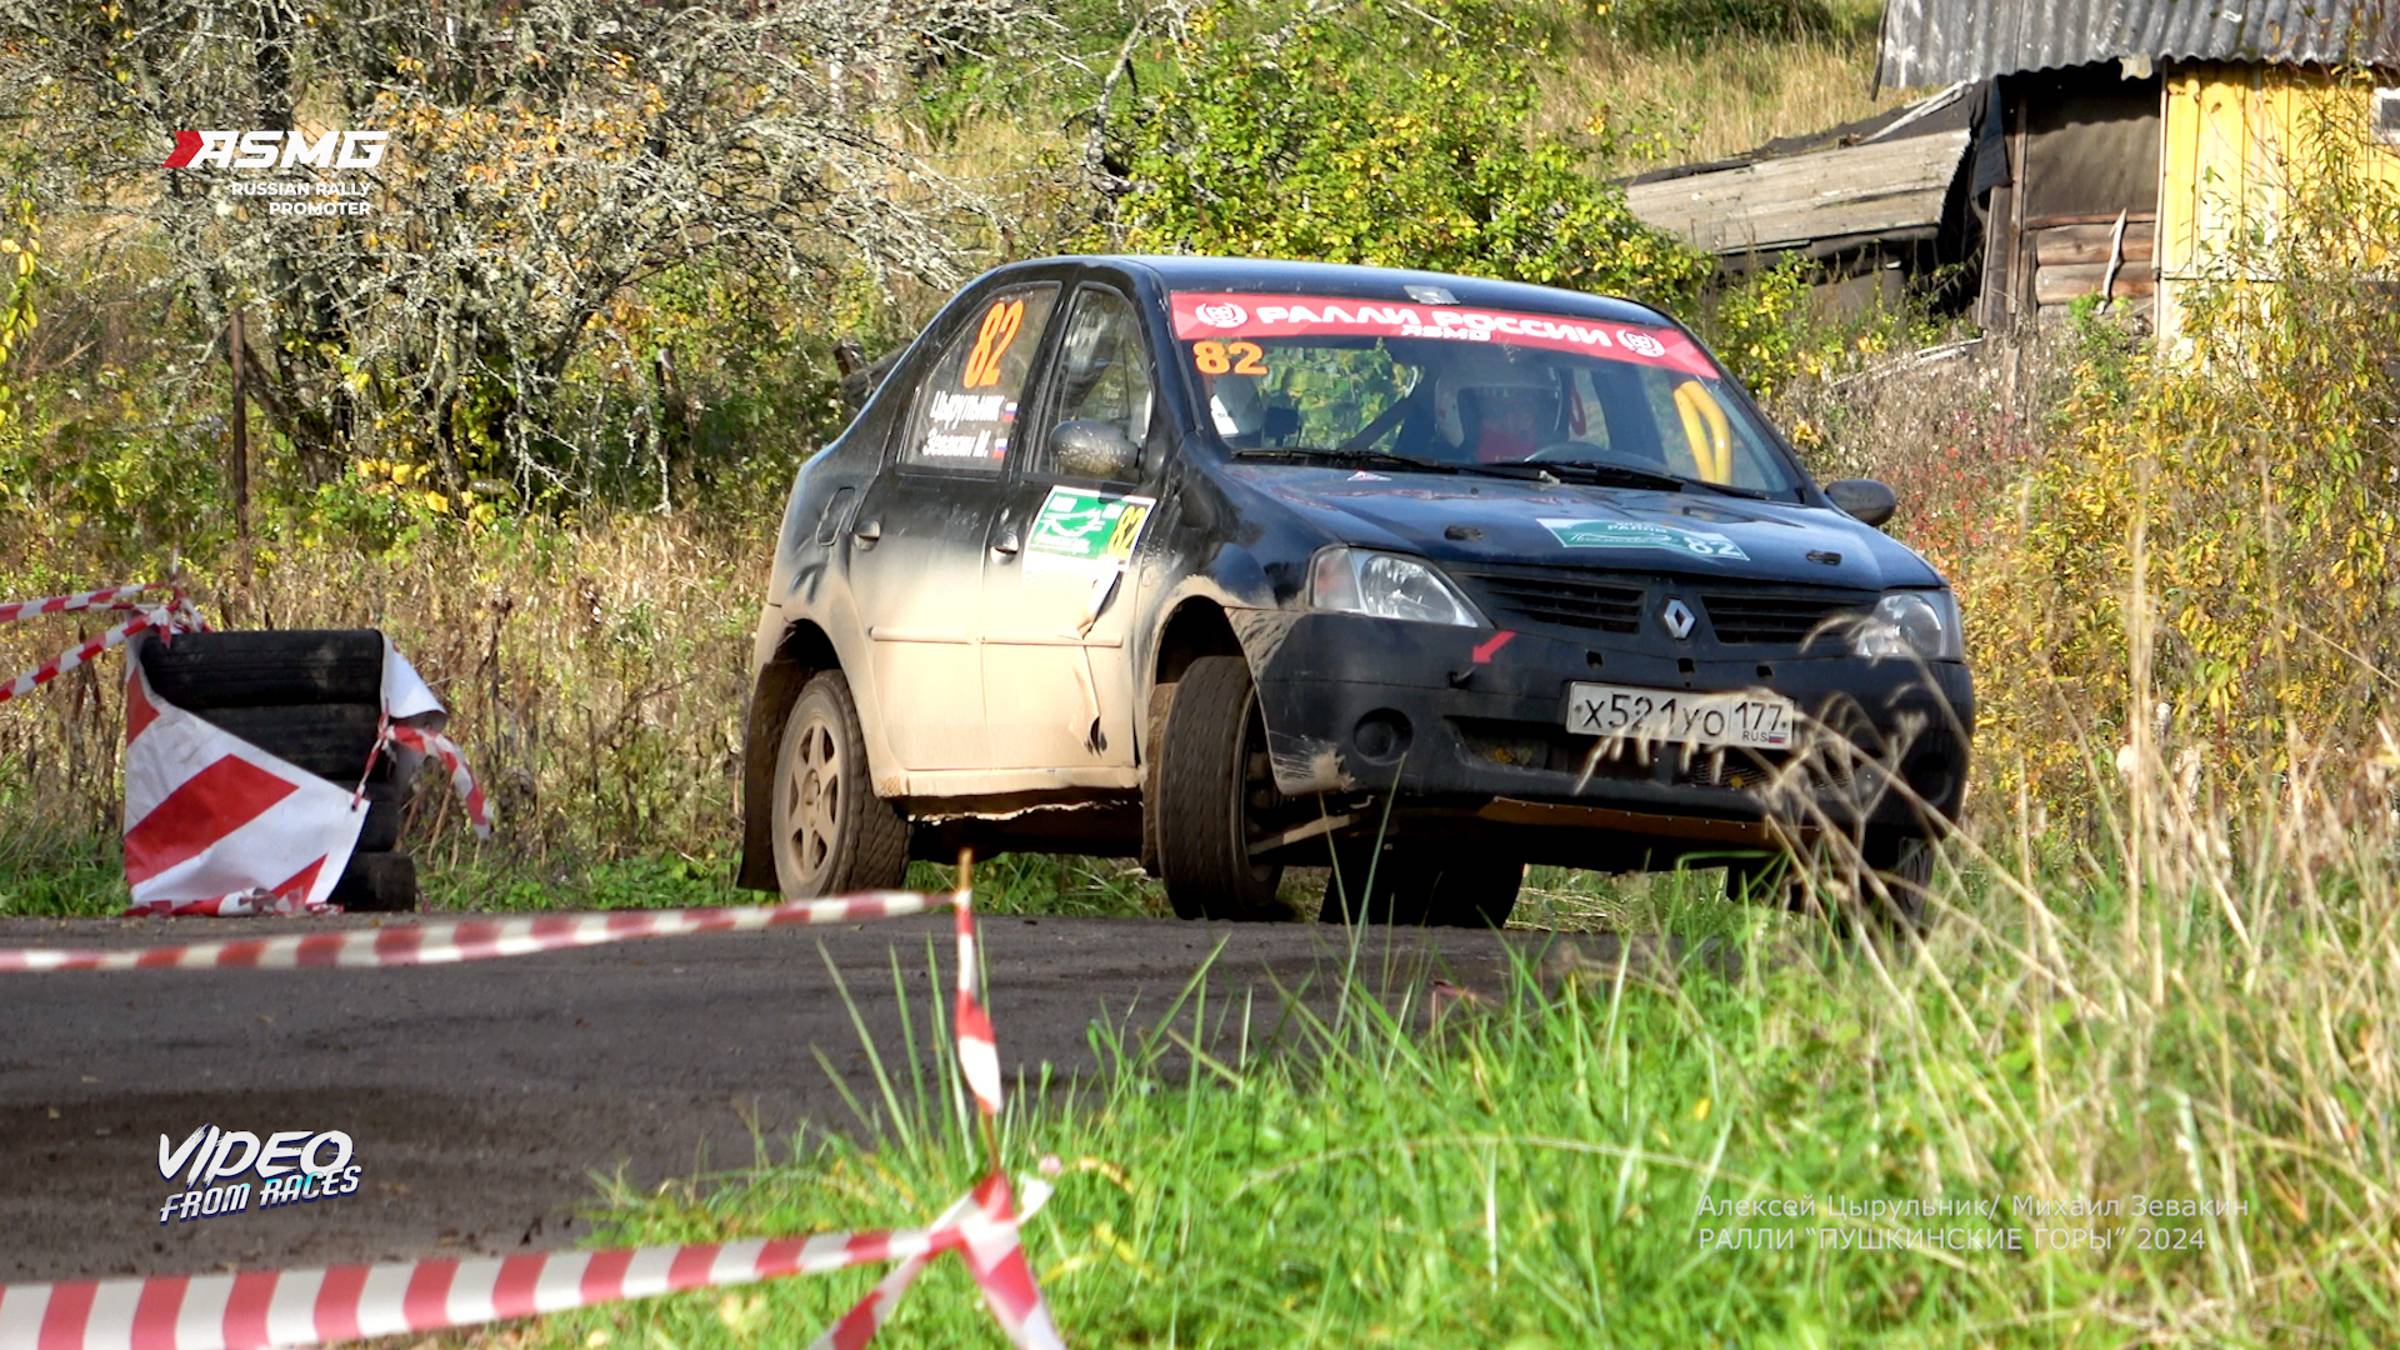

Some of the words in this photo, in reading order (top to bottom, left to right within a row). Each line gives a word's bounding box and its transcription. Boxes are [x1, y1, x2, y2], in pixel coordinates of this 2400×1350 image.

[963, 299, 1025, 389] 82
[1256, 305, 1421, 325] РАЛЛИ
[1431, 310, 1613, 347] РОССИИ
[1192, 340, 1269, 376] 82
[1107, 504, 1147, 560] 82
[1683, 536, 1743, 557] 82
[1735, 700, 1784, 732] 177
[1742, 730, 1769, 743] RUS
